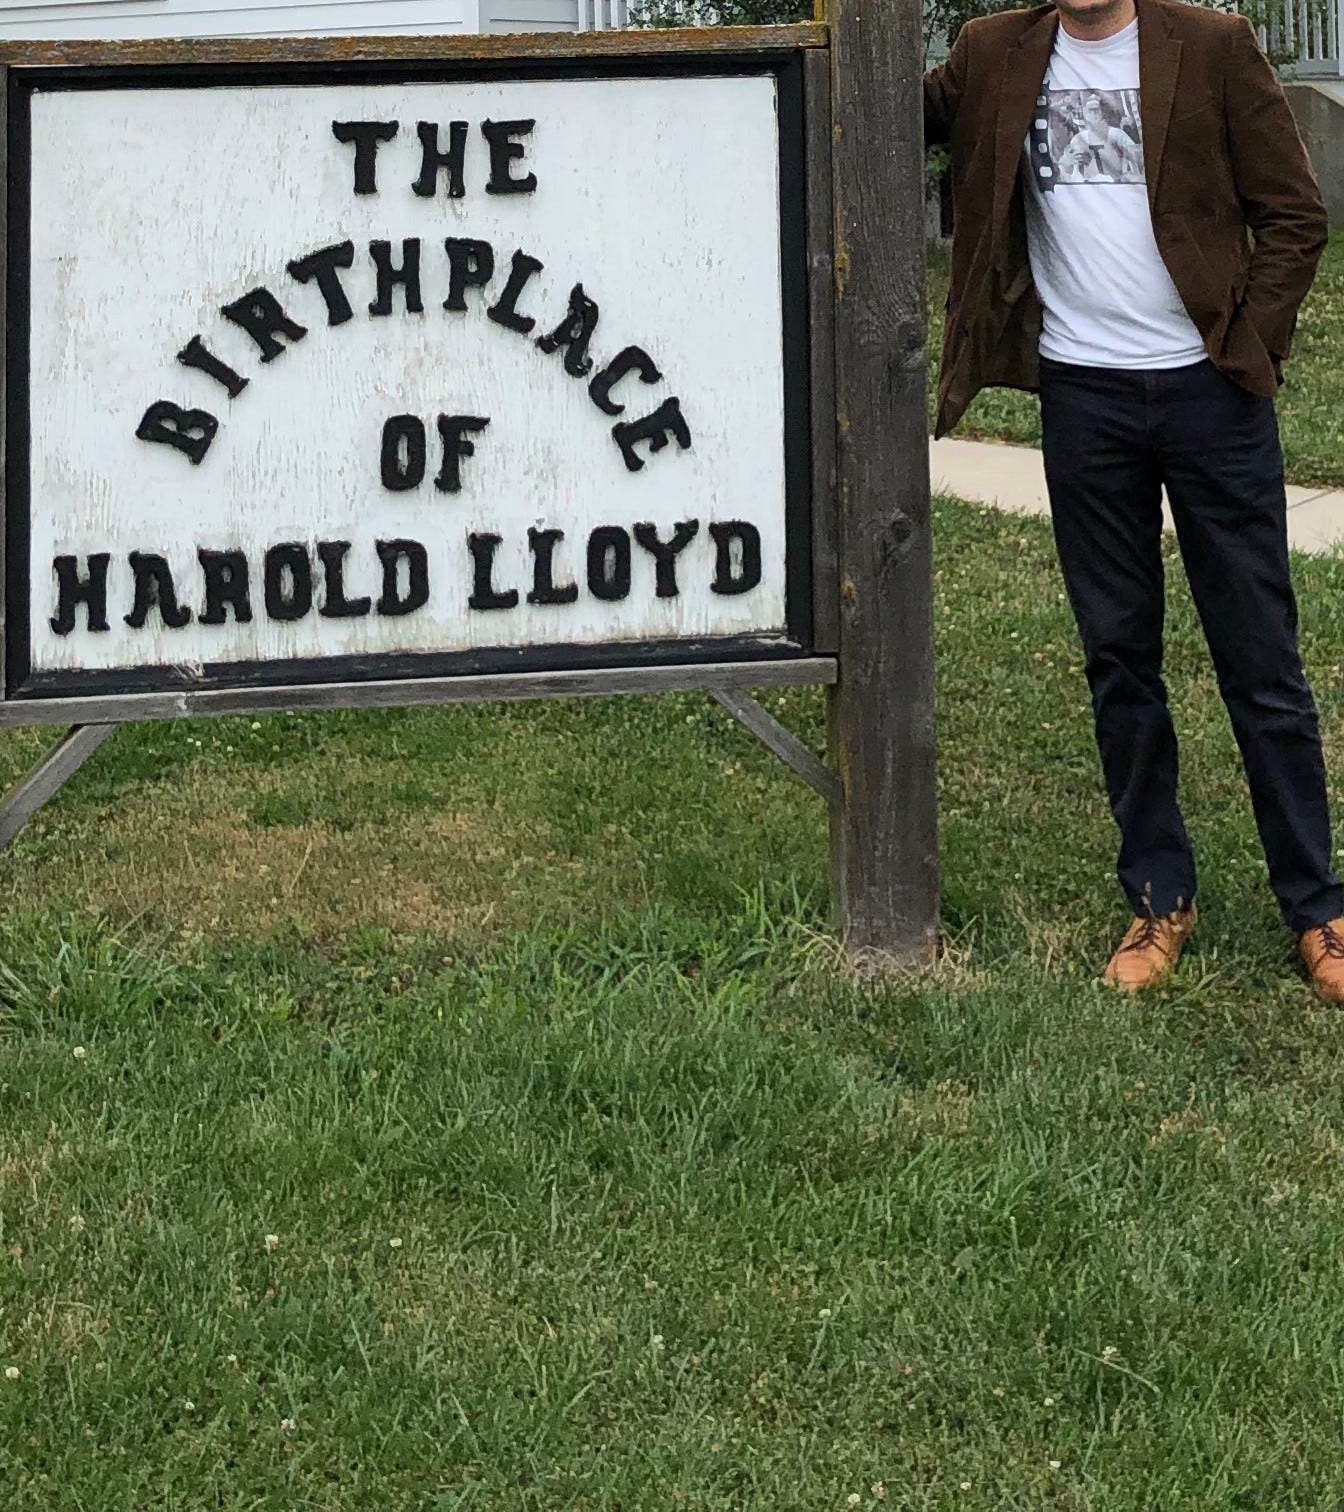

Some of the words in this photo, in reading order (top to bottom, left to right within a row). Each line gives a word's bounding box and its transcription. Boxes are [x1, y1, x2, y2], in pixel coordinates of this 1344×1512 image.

[331, 118, 538, 200] THE
[135, 236, 692, 473] BIRTHPLACE
[380, 413, 491, 494] OF
[49, 538, 430, 638] HAROLD
[466, 518, 762, 612] LLOYD
